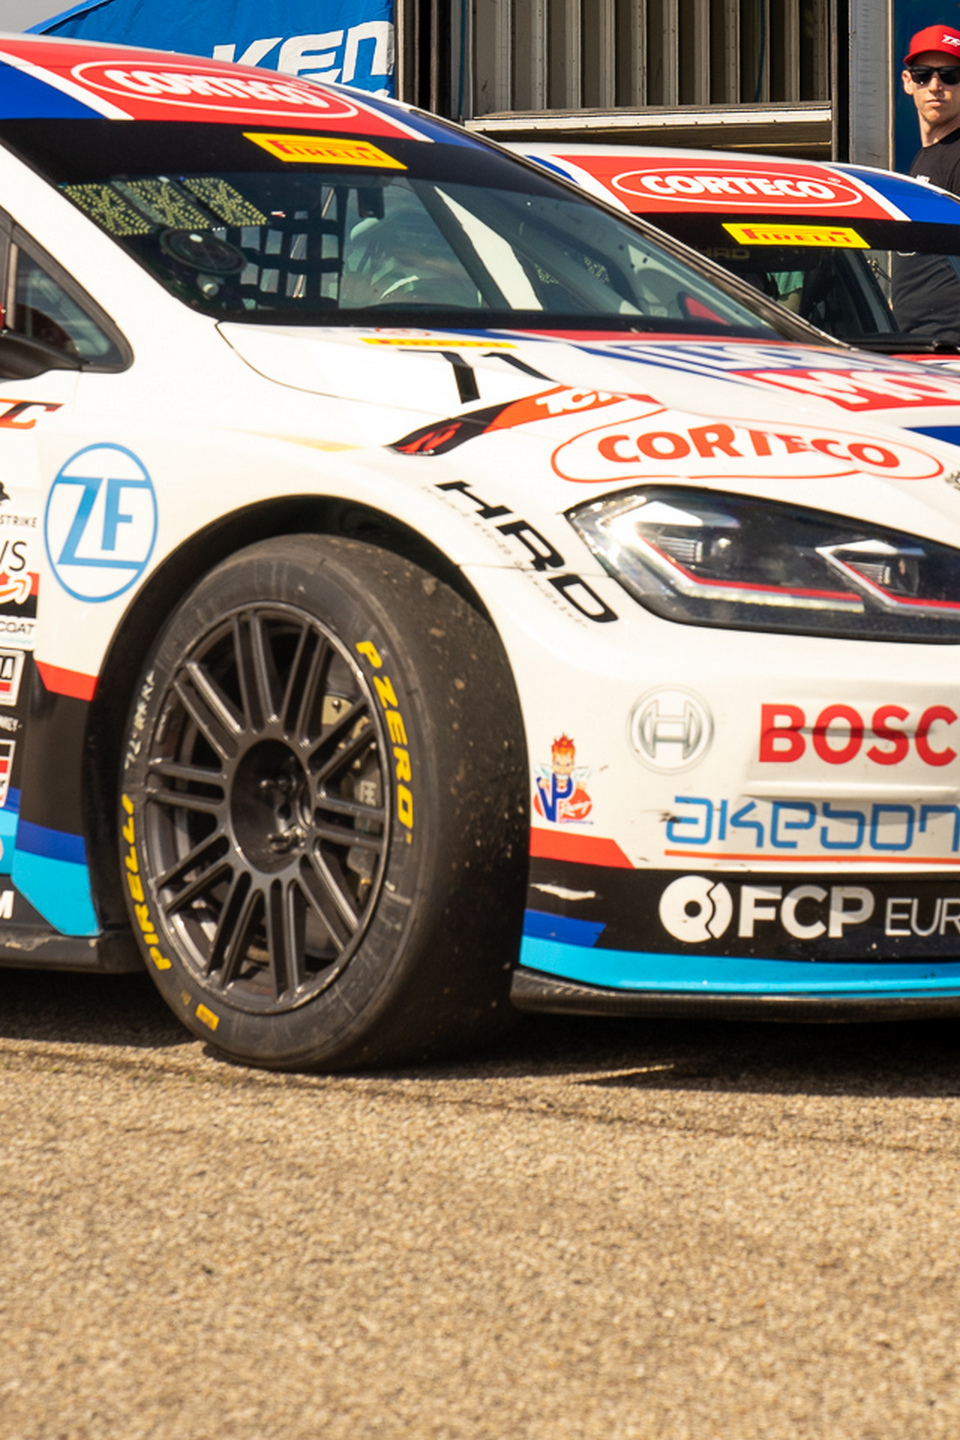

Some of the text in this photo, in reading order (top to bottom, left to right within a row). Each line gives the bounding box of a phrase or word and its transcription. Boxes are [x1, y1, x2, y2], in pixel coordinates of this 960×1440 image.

[103, 69, 331, 109] CORTECO
[267, 138, 385, 162] PIRELLI
[640, 175, 836, 200] CORTECO
[741, 228, 852, 244] PIRELLI
[597, 423, 900, 468] CORTECO
[50, 474, 152, 571] ZF
[121, 793, 172, 971] PIRELLI
[737, 884, 875, 939] FCP
